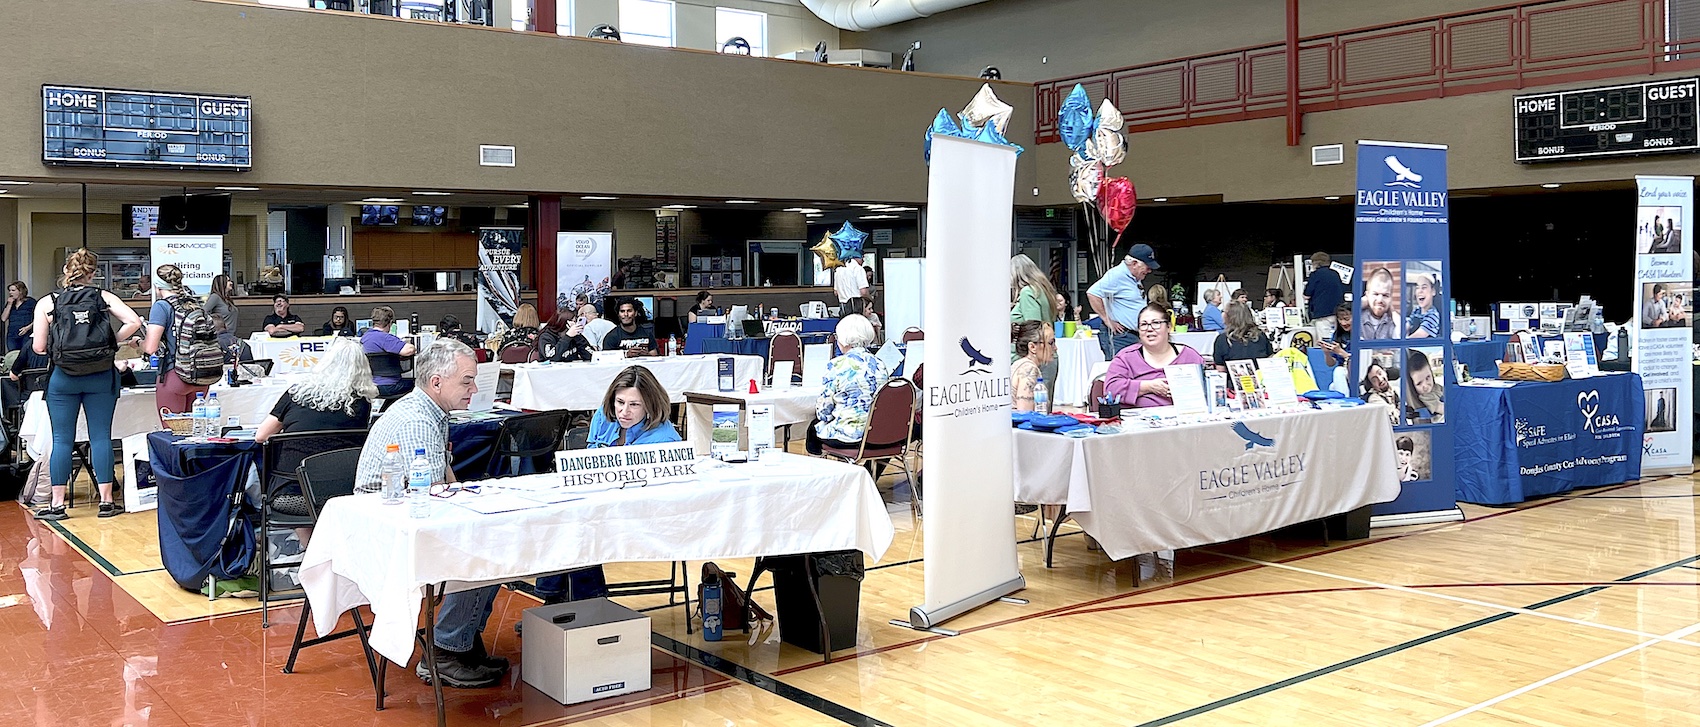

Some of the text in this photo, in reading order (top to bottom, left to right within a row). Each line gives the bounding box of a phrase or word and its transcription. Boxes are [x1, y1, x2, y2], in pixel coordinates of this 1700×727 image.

[1648, 84, 1695, 100] GUEST
[48, 92, 97, 108] HOME
[1518, 98, 1556, 114] HOME
[201, 102, 248, 116] GUEST
[137, 131, 168, 139] PERIOD
[1644, 138, 1673, 148] BONUS
[74, 147, 107, 158] BONUS
[196, 153, 226, 162] BONUS
[1537, 146, 1565, 155] BONUS
[1357, 190, 1446, 208] EAGLE VALLEY
[493, 255, 521, 264] EVERY
[930, 382, 970, 406] EAGLE
[954, 404, 998, 418] Children's Home
[1595, 414, 1620, 428] CASA
[1528, 425, 1546, 438] SAFE
[560, 453, 622, 472] DANGBERG
[625, 450, 656, 466] HOME
[660, 447, 695, 464] RANCH
[564, 464, 696, 487] HISTORIC PARK
[1200, 453, 1306, 490] EAGLE VALLEY
[1228, 484, 1280, 499] Children's Home
